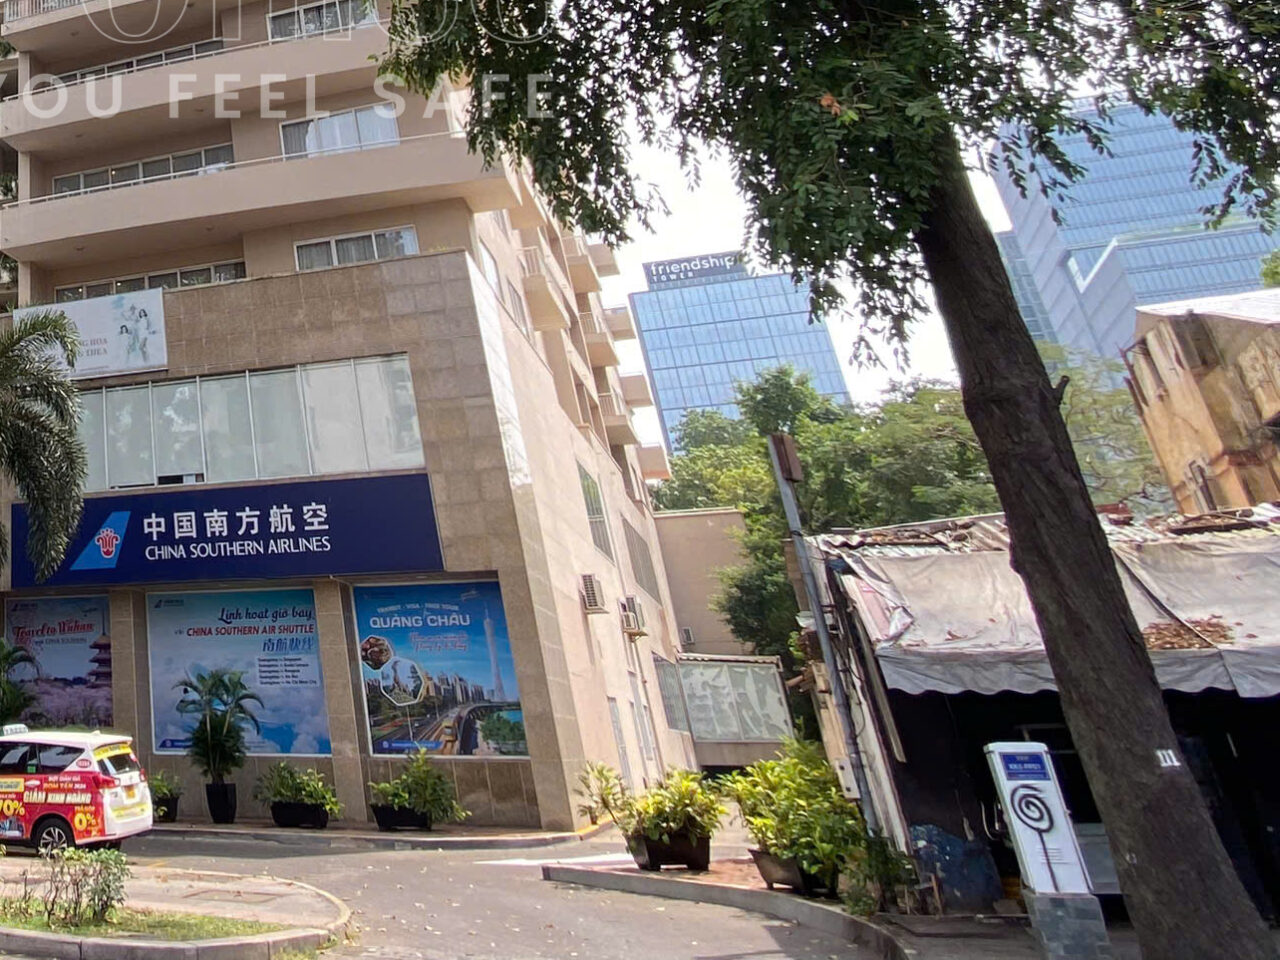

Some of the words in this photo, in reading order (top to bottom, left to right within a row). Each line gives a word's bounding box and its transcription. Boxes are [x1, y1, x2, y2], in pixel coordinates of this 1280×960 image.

[651, 256, 735, 275] friendship
[653, 271, 694, 282] TOWER
[143, 502, 329, 541] 中国南方航空
[145, 545, 187, 561] CHINA
[190, 540, 264, 558] SOUTHERN
[268, 536, 331, 554] AIRLINES
[218, 607, 242, 624] Linh
[369, 613, 423, 629] QUẢNG
[426, 612, 470, 627] CHÂU
[58, 620, 94, 634] Wuhan
[186, 627, 213, 637] CHINA
[215, 625, 259, 636] SOUTHERN
[261, 625, 276, 635] AIR
[278, 624, 314, 634] SHUTTLE
[74, 812, 97, 831] 0%
